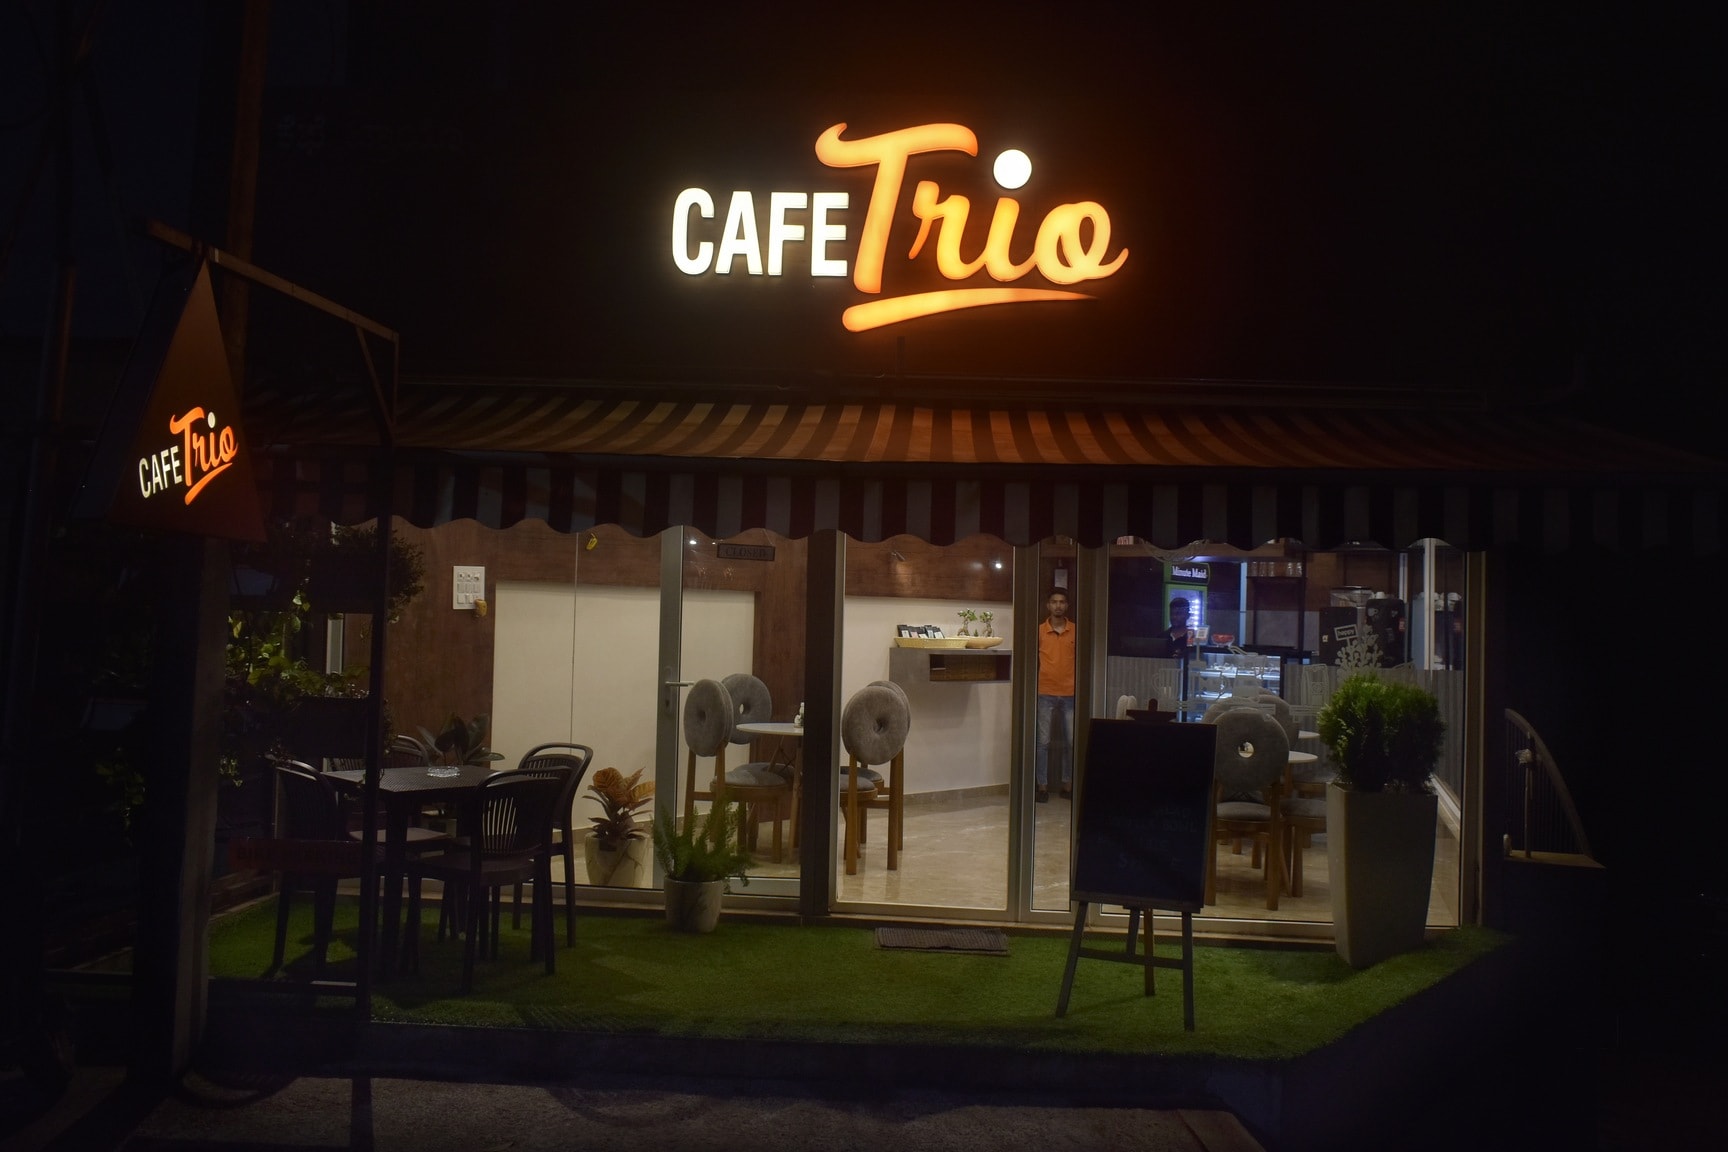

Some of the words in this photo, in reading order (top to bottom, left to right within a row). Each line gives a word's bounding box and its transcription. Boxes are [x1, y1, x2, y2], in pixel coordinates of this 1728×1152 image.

[672, 187, 849, 276] CAFE
[815, 122, 1128, 294] Trio
[139, 446, 182, 498] CAFE
[170, 406, 239, 488] Trio
